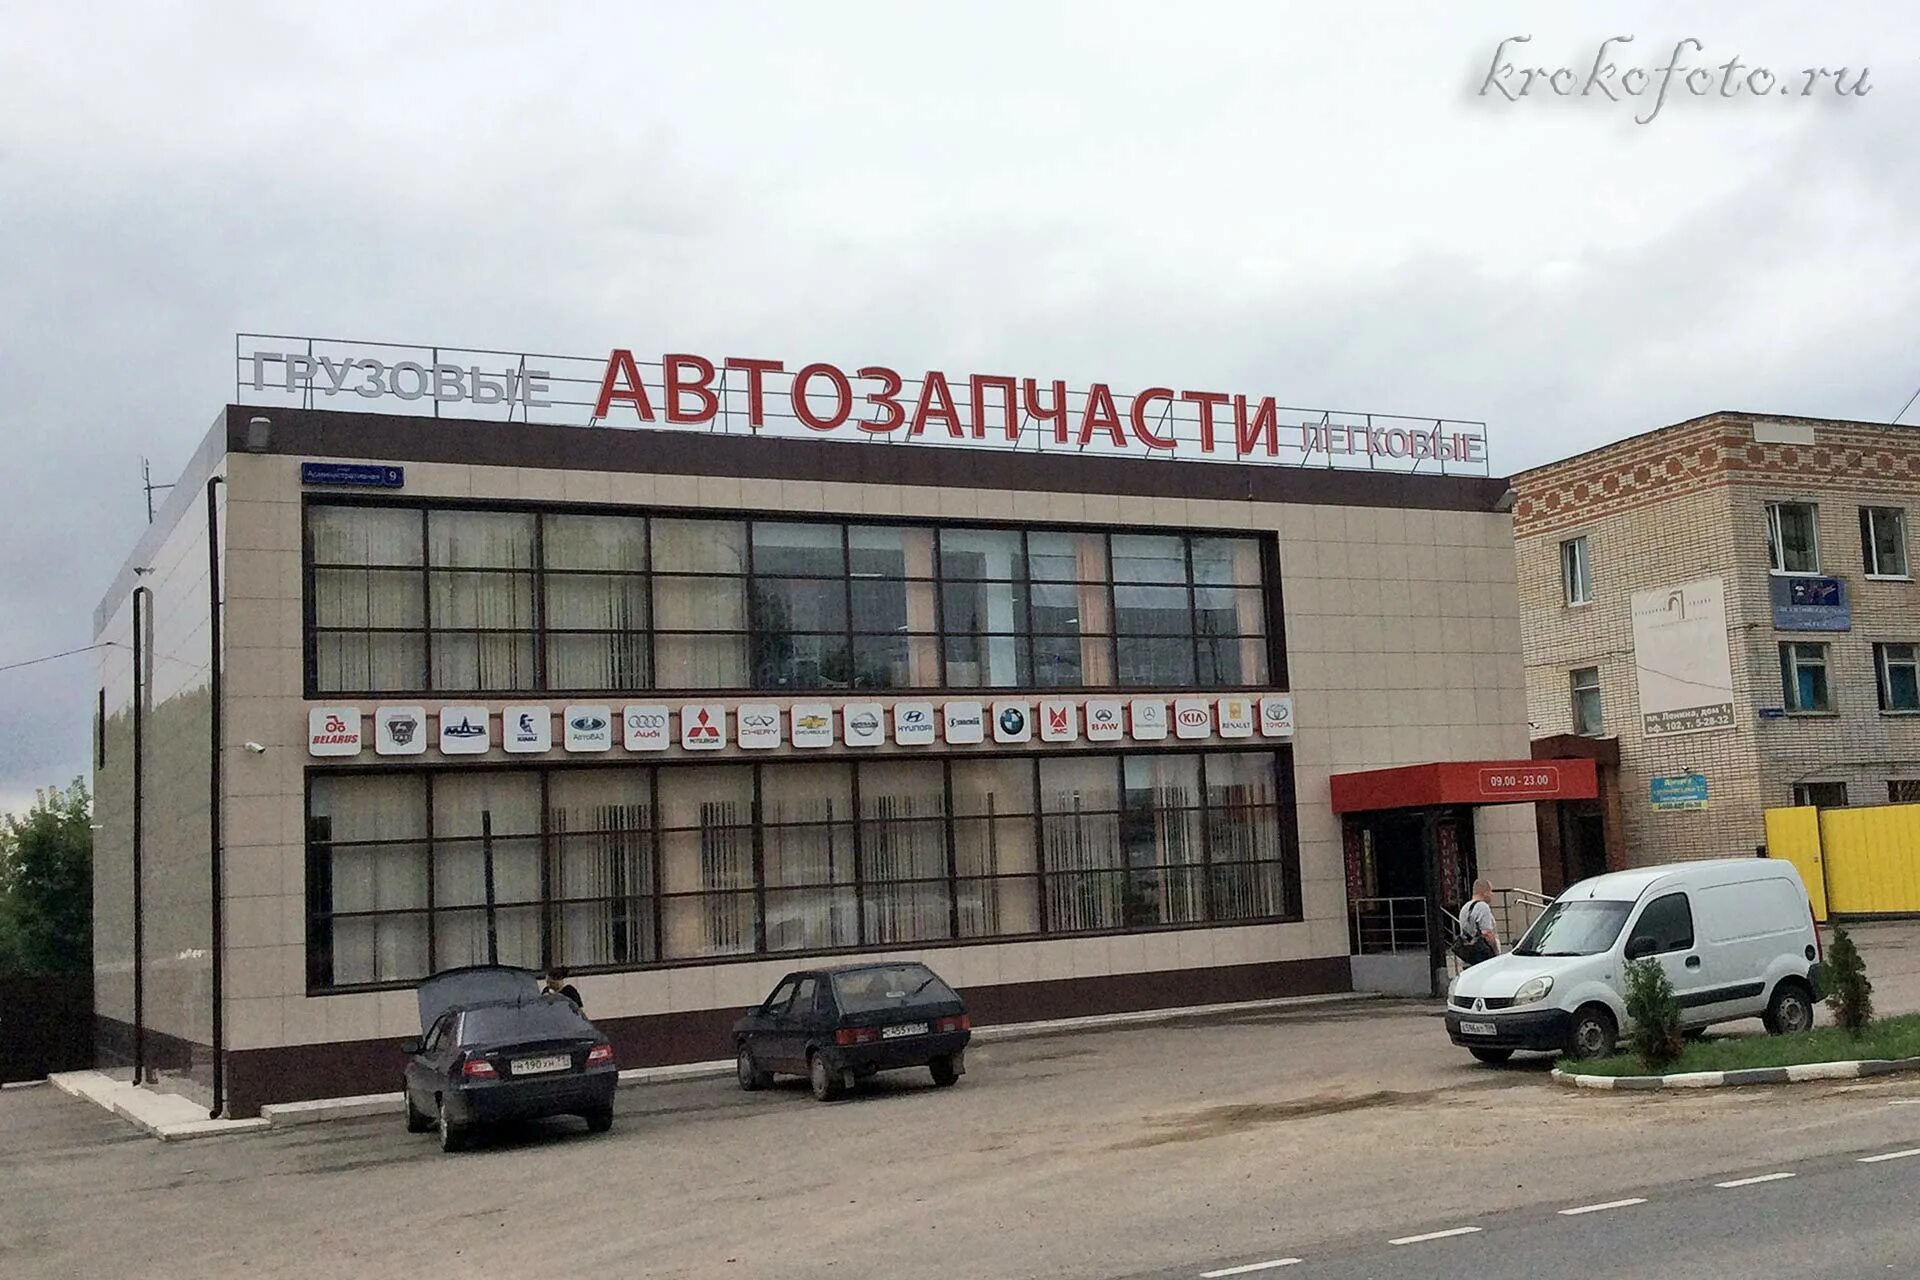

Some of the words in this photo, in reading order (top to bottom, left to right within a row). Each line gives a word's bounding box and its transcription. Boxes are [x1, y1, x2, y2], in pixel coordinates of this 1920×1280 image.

[254, 352, 552, 408] ГРУЗОВЫЕ
[592, 349, 1279, 457] АВТОЗАПЧАСТИ
[1301, 421, 1484, 463] ЛЕГКОВЫЕ
[389, 470, 397, 481] 9
[1091, 723, 1119, 731] BAW
[312, 734, 359, 745] BELARUS
[1490, 775, 1516, 787] 09.00
[1523, 774, 1549, 786] 23.00
